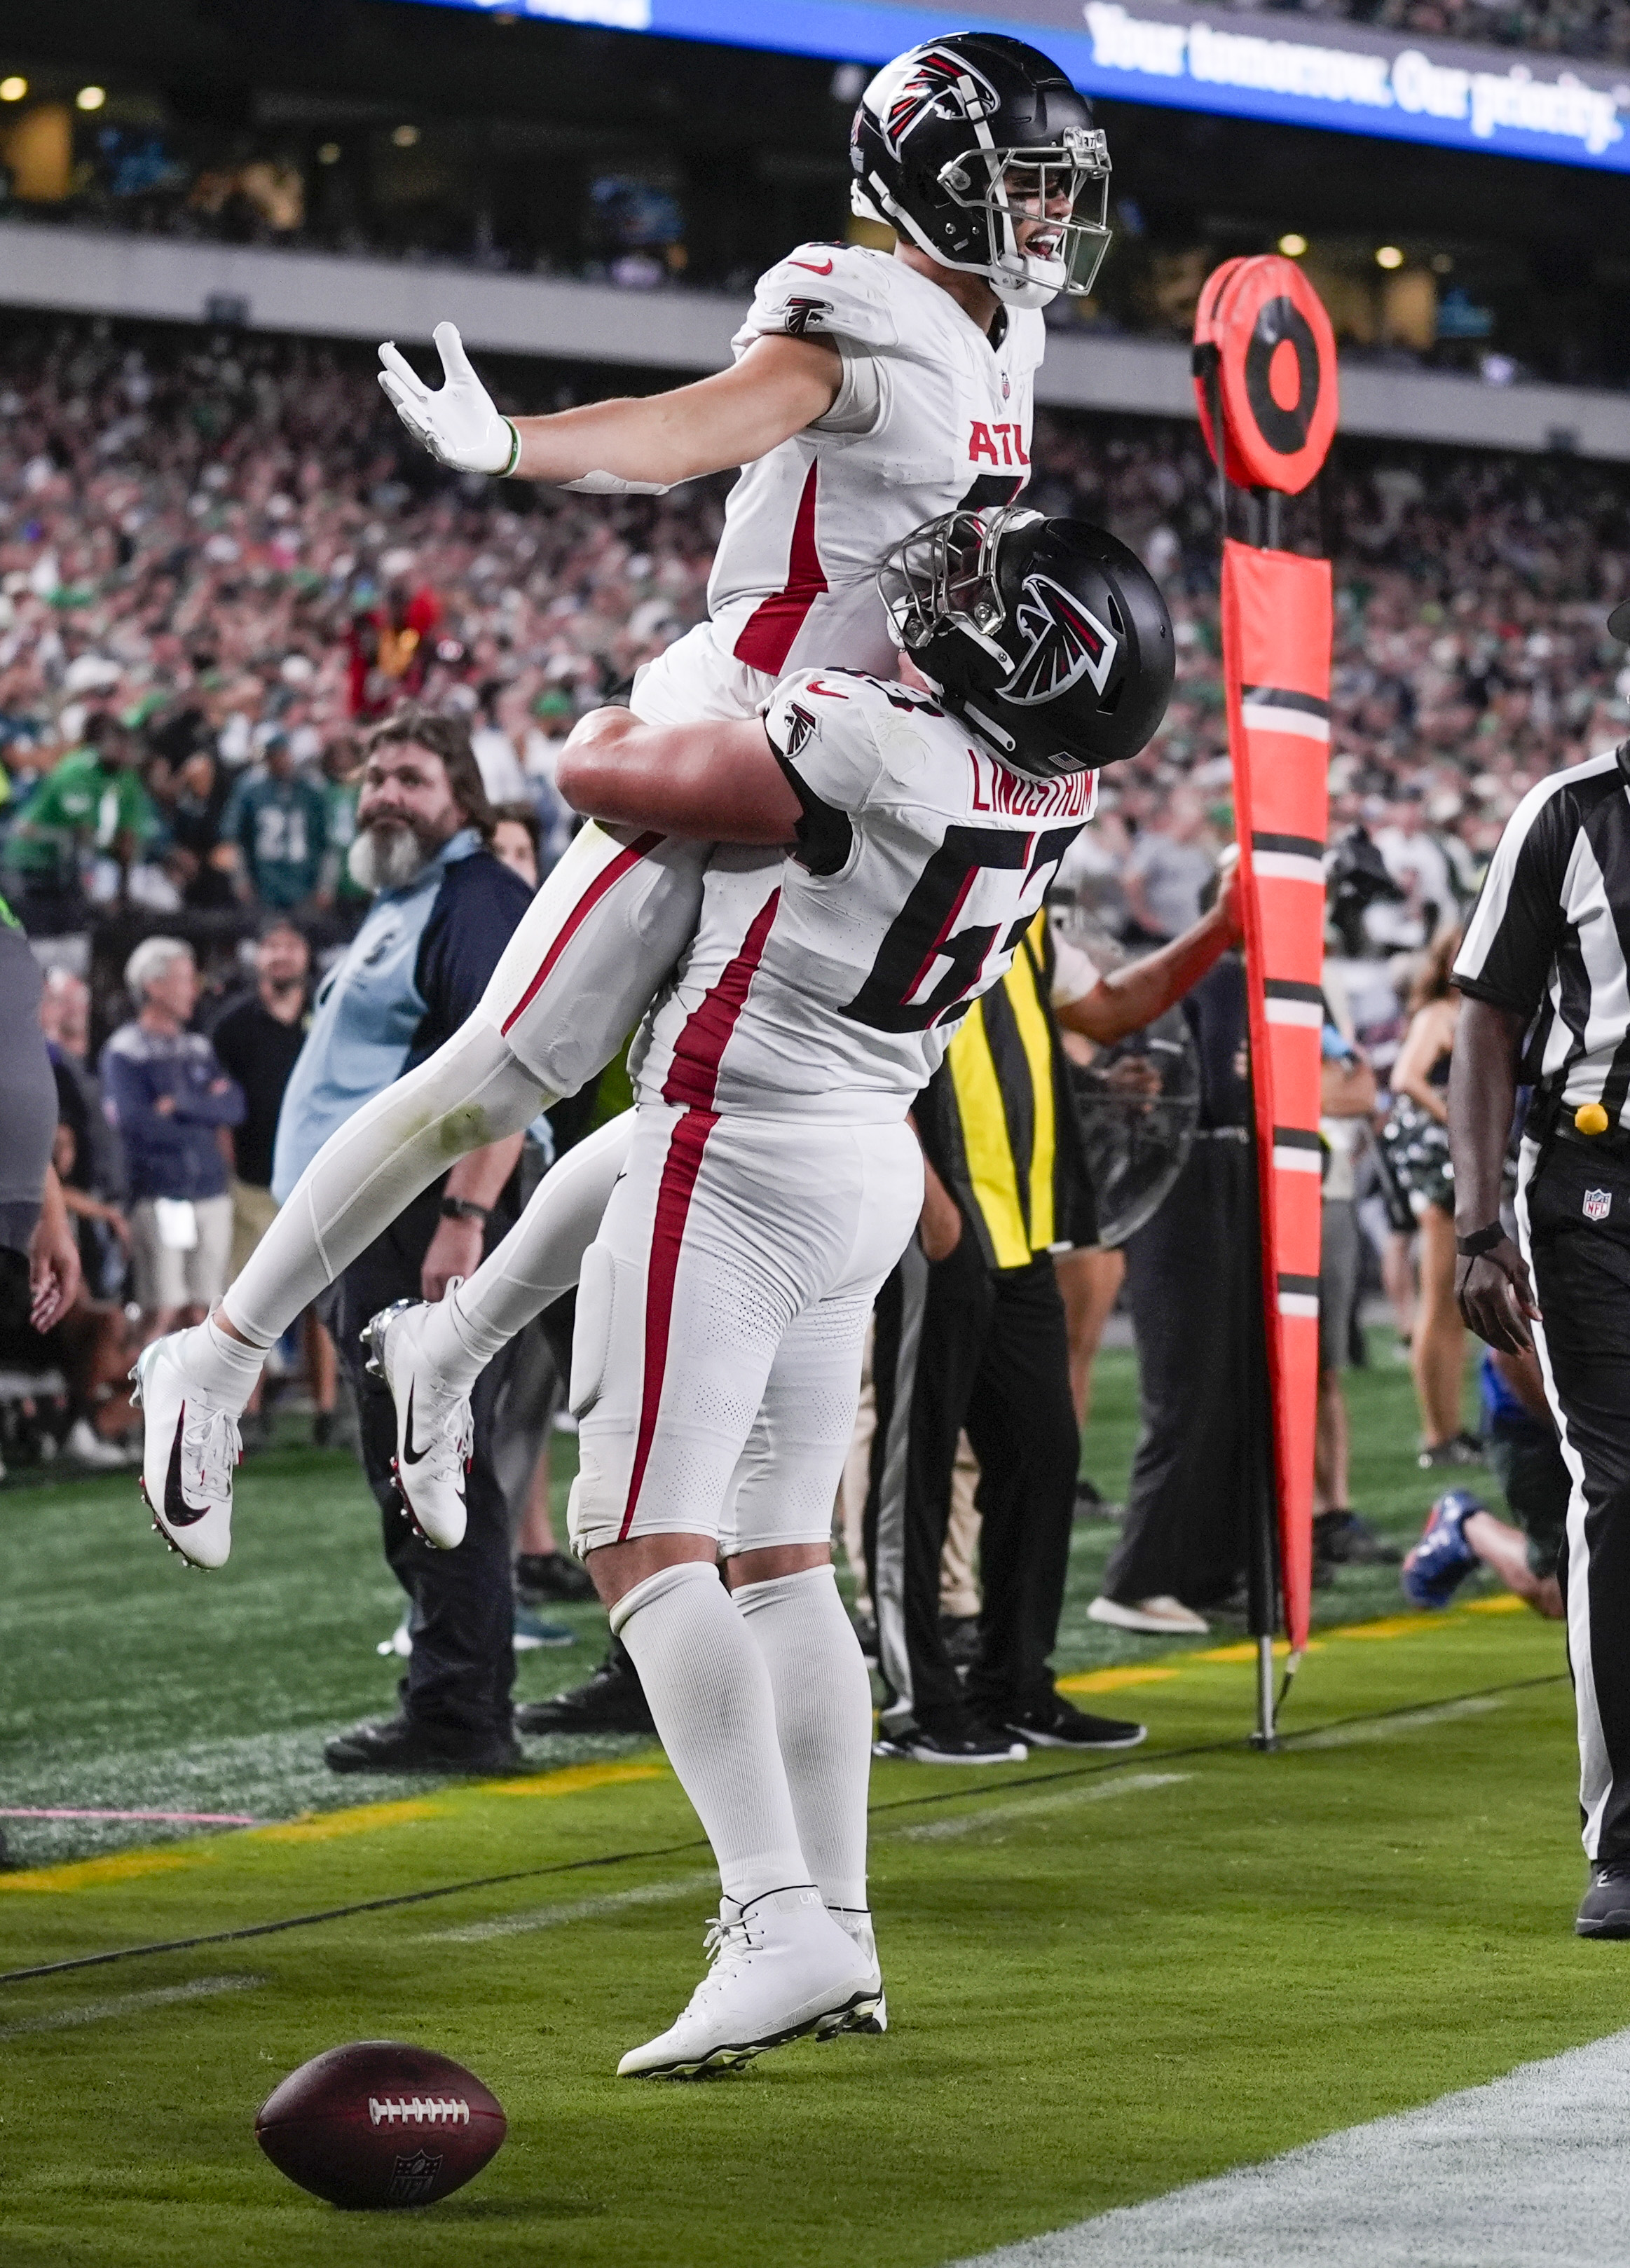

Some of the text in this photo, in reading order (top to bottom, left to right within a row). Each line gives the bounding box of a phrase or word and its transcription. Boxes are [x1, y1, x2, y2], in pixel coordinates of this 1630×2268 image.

[1084, 1, 1183, 76] Your
[1392, 50, 1470, 119] Our
[969, 420, 1031, 465] ATL
[1587, 1202, 1605, 1216] NFL
